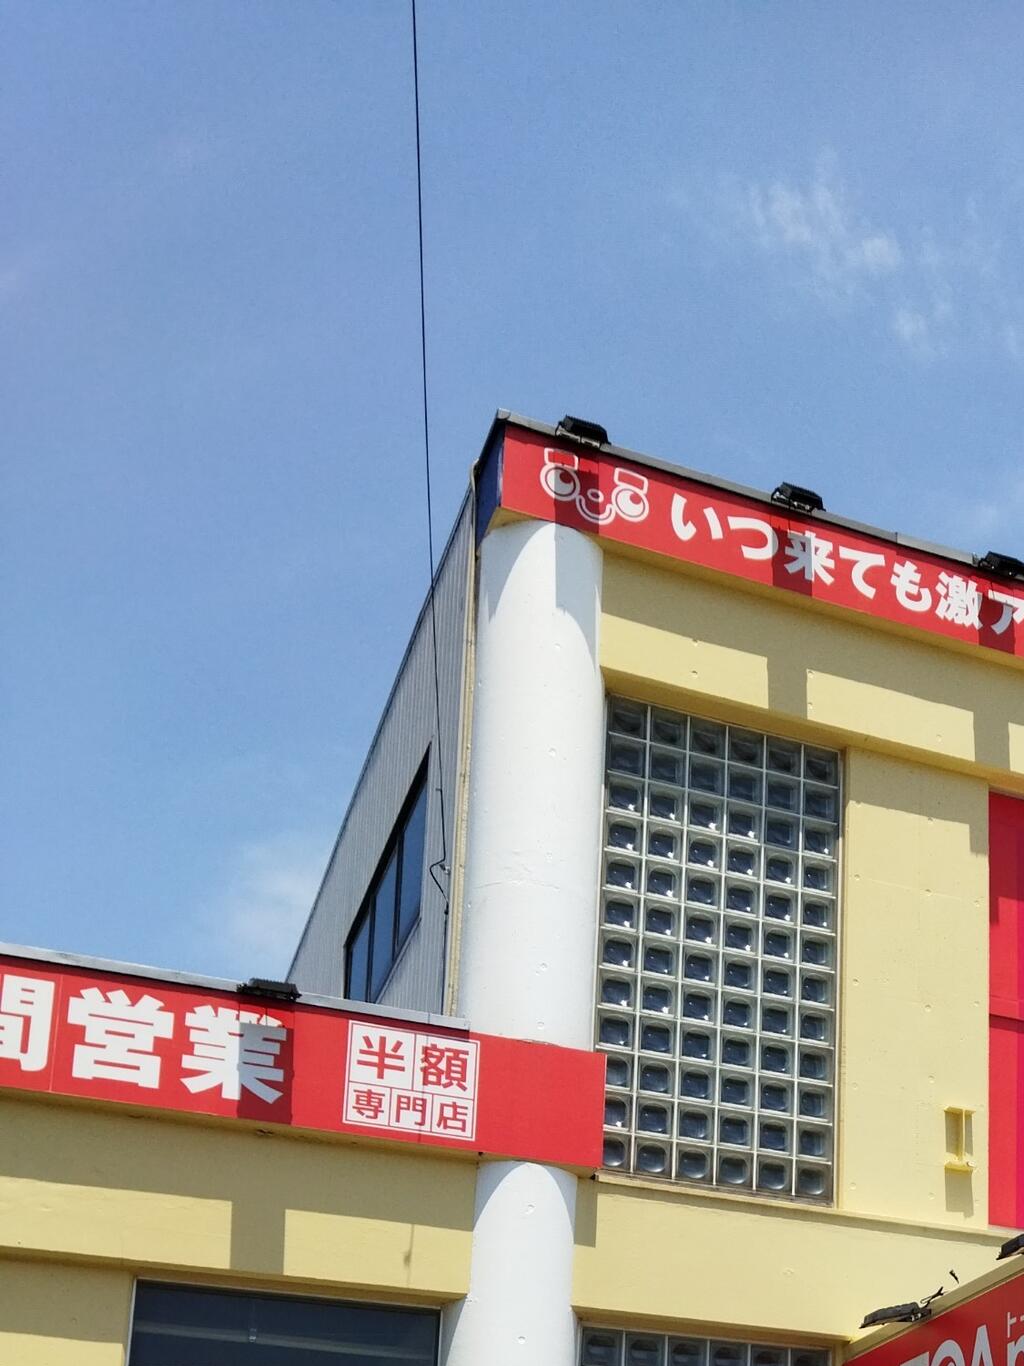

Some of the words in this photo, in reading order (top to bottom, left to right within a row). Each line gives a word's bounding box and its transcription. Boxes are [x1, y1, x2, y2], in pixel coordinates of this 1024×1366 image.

[356, 1034, 469, 1093] 半額
[351, 1088, 469, 1134] 専門店
